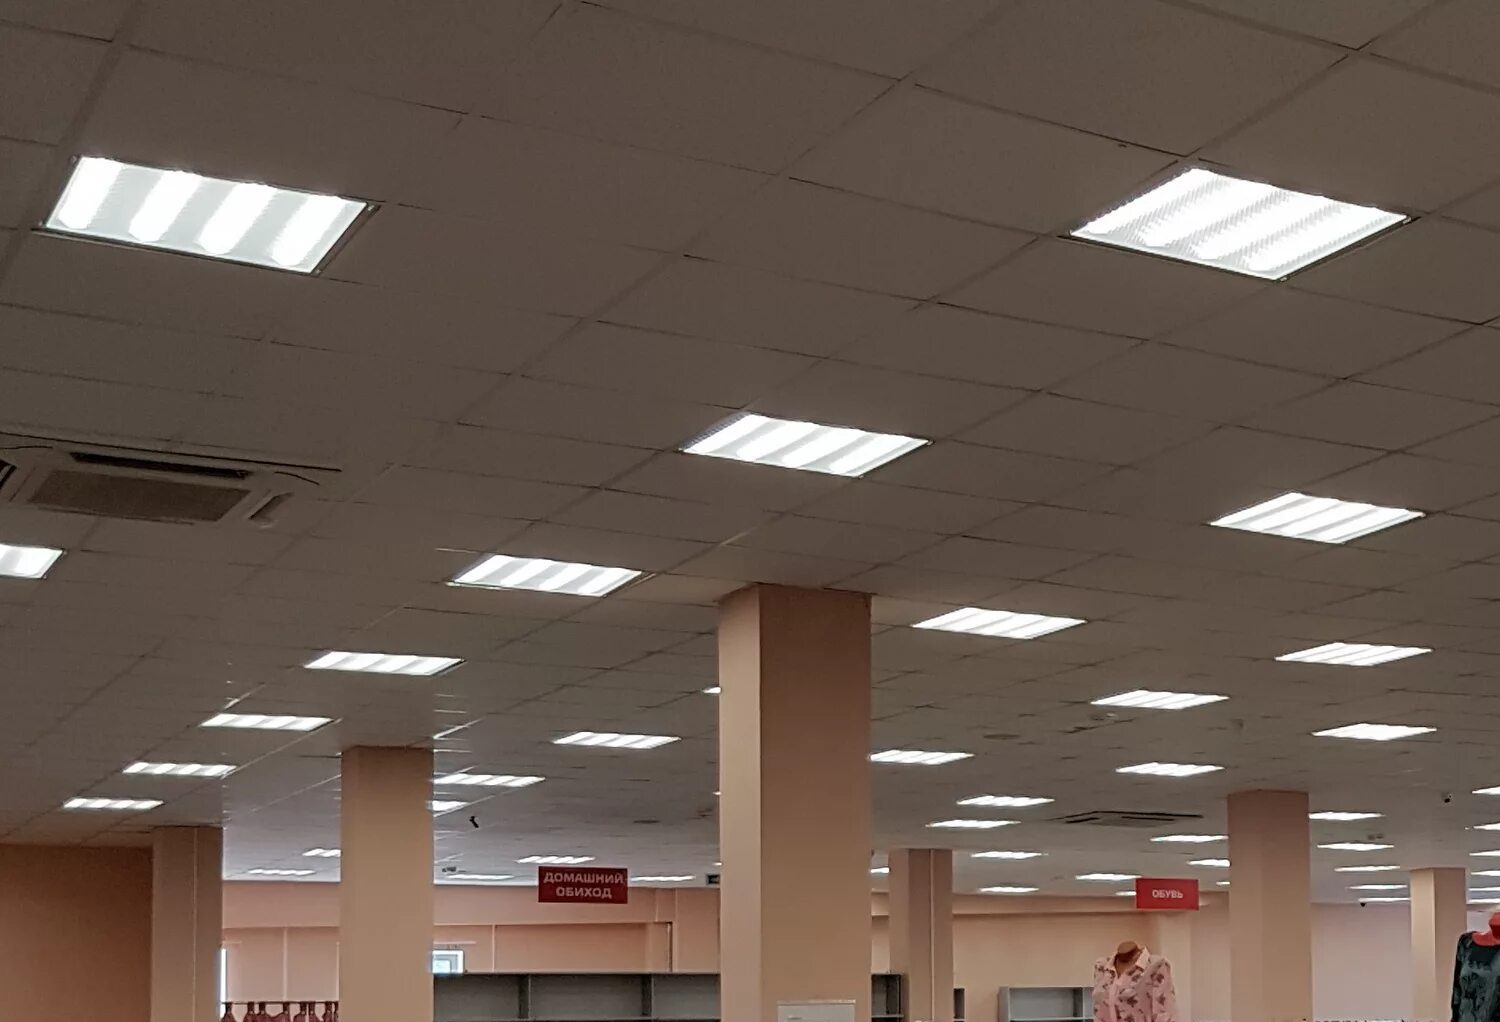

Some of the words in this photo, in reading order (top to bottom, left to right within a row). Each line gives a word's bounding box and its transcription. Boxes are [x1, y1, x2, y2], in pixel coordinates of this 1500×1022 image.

[543, 872, 624, 884] ДОМАШНИЙ
[555, 887, 612, 899] ОБИХОД
[1152, 889, 1184, 899] ОБУВЬ
